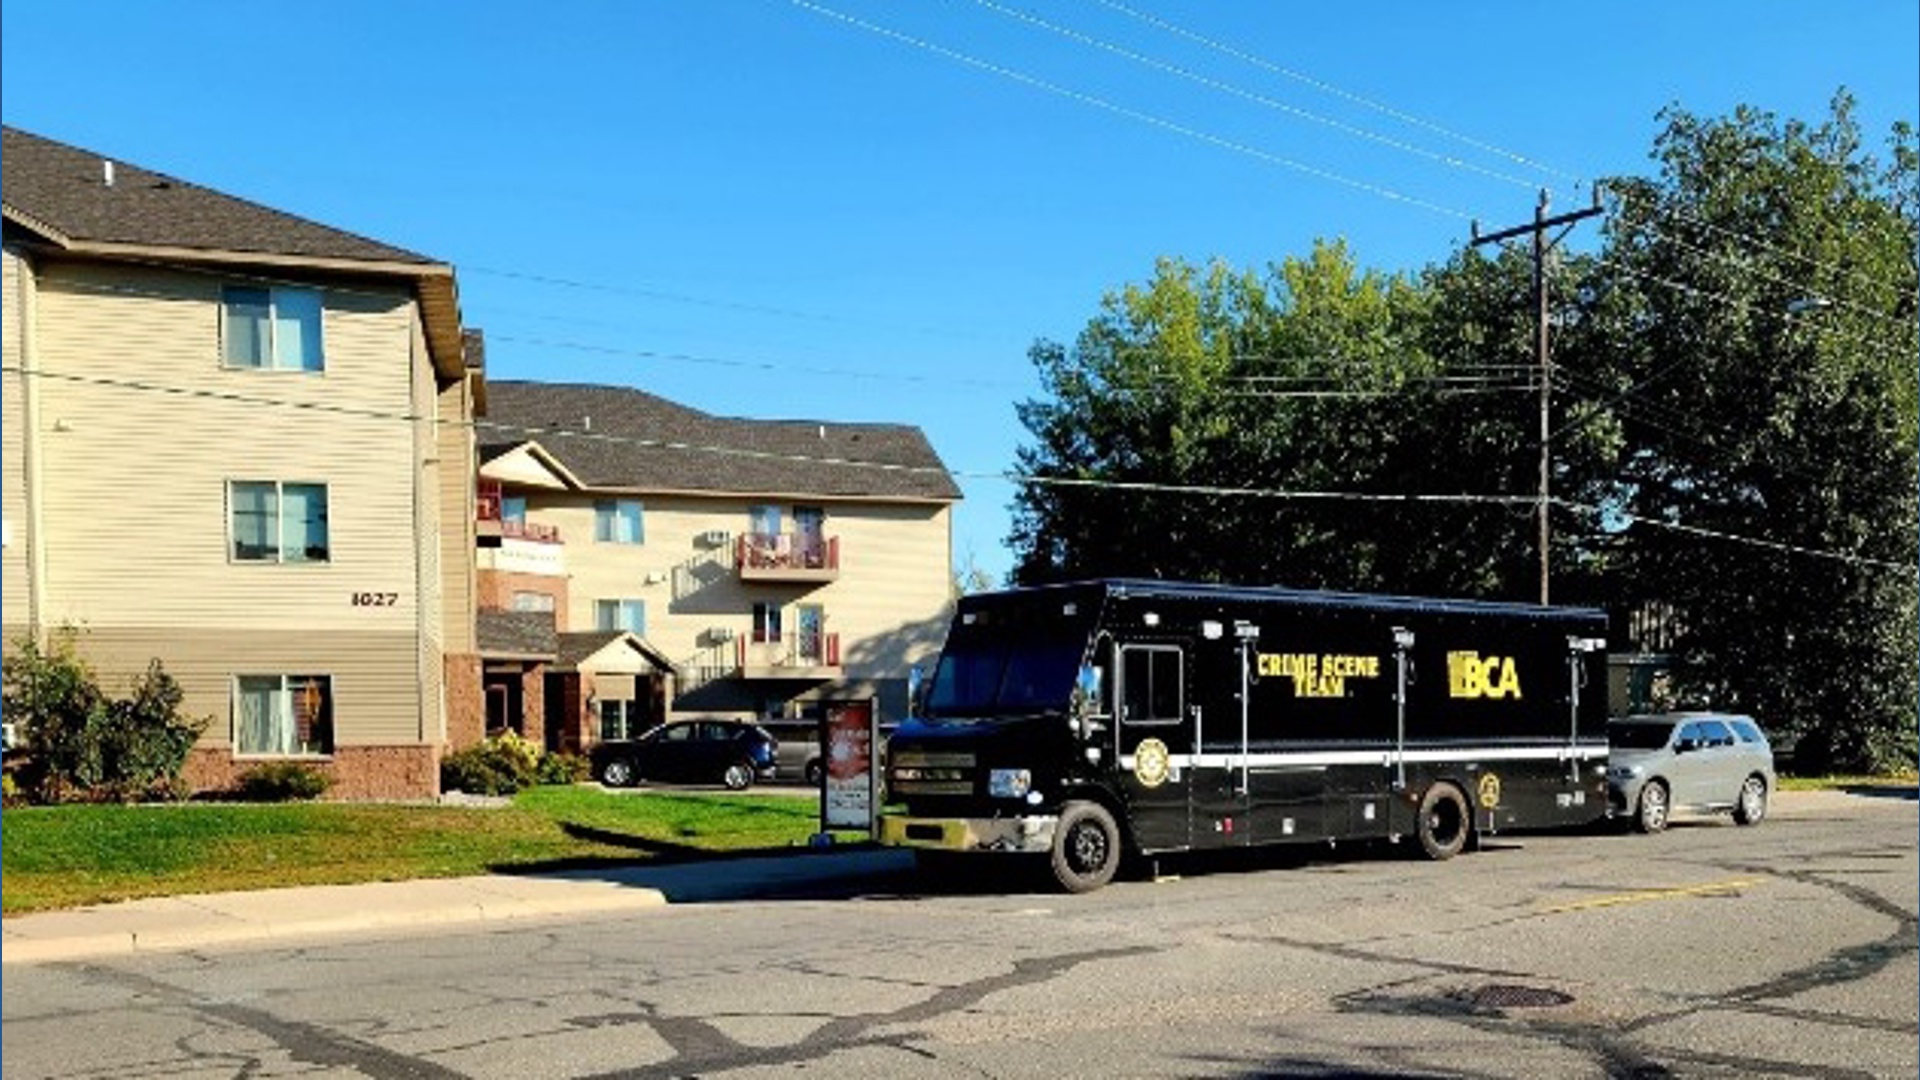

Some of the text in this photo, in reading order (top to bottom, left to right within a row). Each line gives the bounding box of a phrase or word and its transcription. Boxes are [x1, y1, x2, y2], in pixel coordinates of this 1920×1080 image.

[351, 592, 398, 606] 1027
[1258, 653, 1379, 677] CRIME SCENE
[1293, 675, 1345, 697] TEAM
[1464, 656, 1521, 699] BCA
